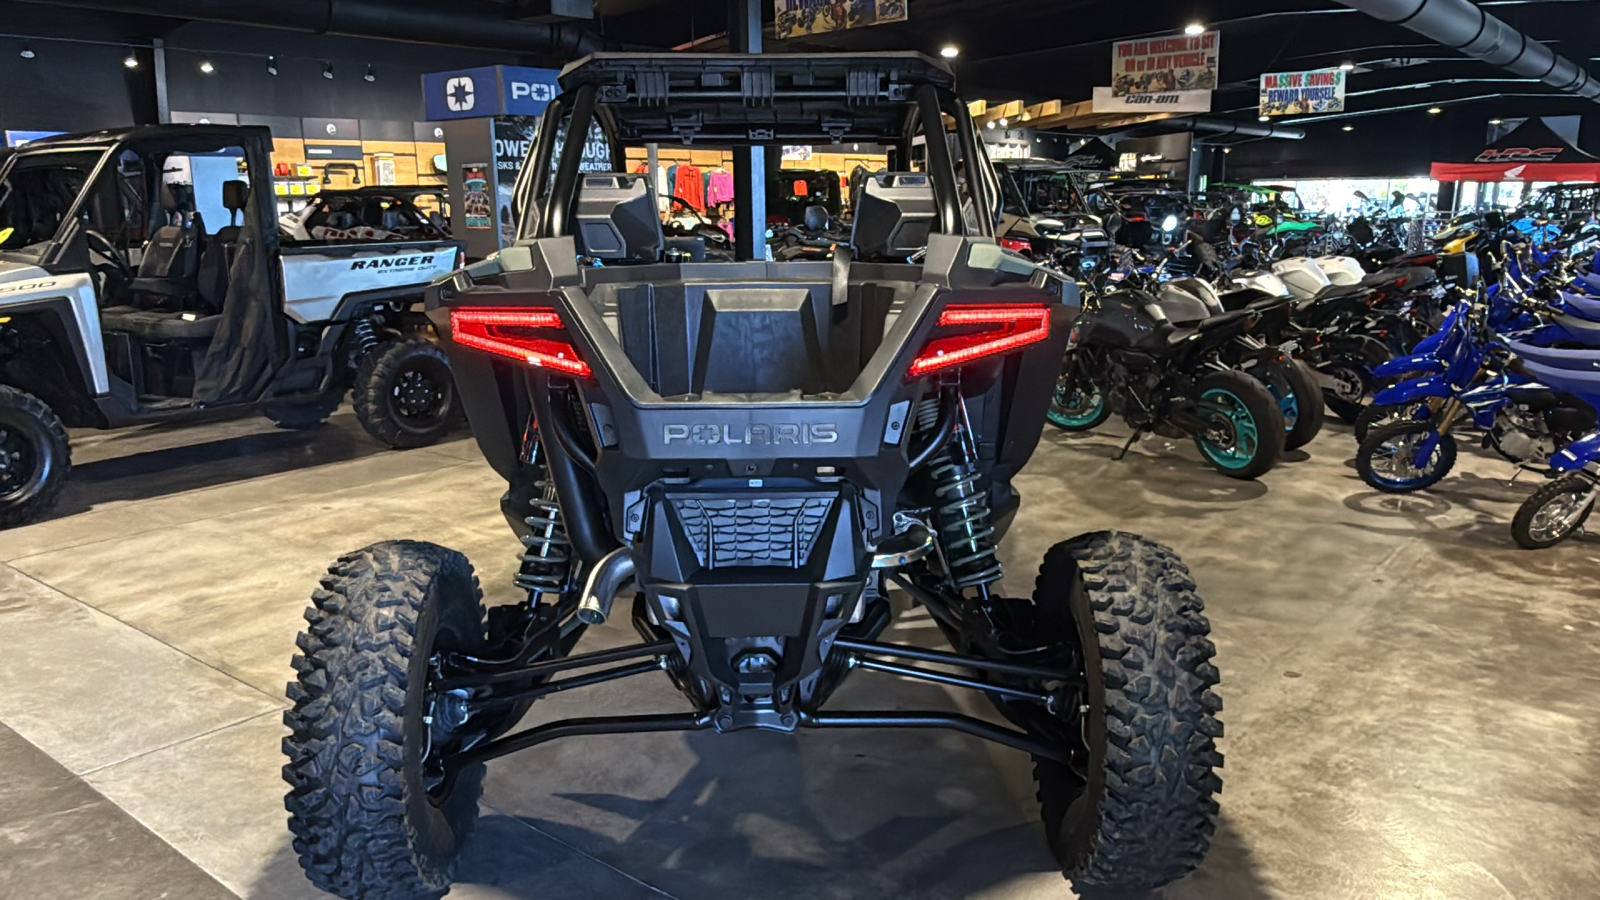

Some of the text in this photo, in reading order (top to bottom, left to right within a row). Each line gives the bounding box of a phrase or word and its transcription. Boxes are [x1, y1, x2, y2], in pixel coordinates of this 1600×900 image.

[1190, 36, 1201, 50] TO
[1202, 34, 1215, 49] SIT
[1173, 52, 1205, 68] VEHICLE
[1265, 71, 1342, 89] MASSIVE SAVINGS
[1268, 88, 1299, 103] REWARD
[1301, 87, 1336, 101] YOURSELF
[350, 255, 435, 270] RANGER
[663, 423, 839, 446] POLARIS
